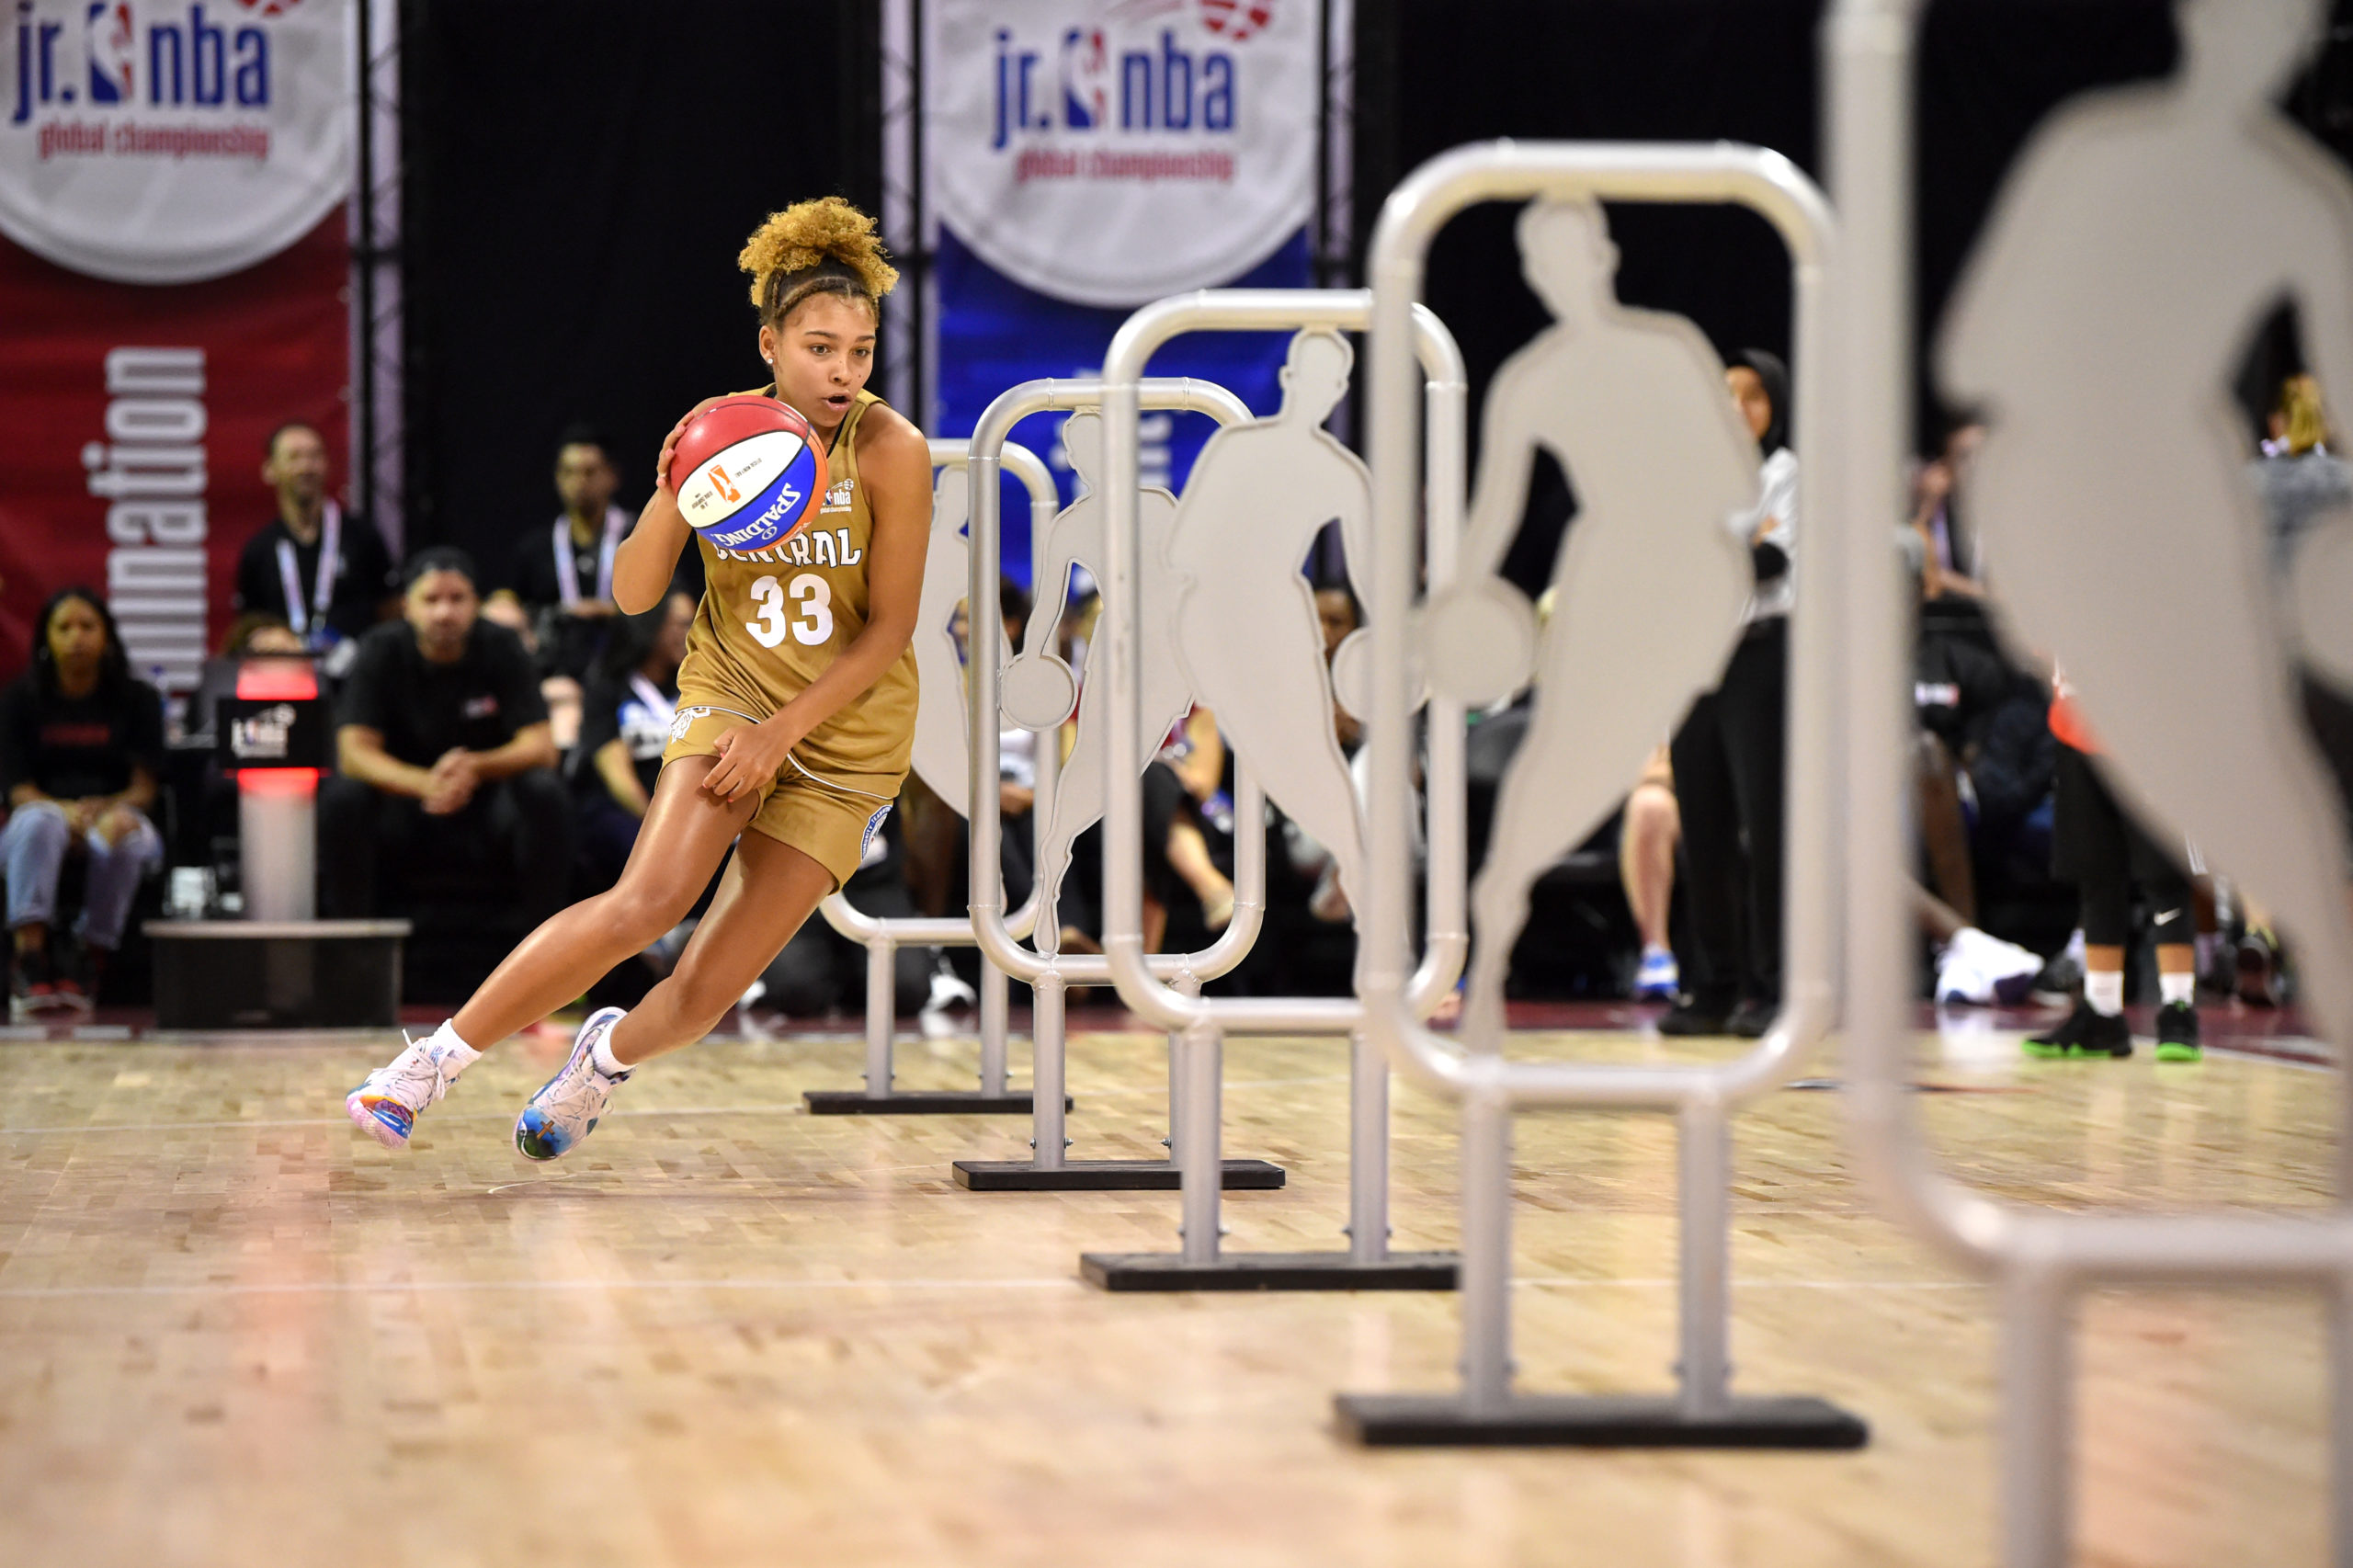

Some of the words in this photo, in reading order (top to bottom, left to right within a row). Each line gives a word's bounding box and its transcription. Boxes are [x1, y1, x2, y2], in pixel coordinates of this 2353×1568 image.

[11, 0, 76, 125] jr.
[148, 3, 270, 107] nba
[992, 28, 1051, 150] jr.
[1120, 30, 1237, 131] nba
[712, 482, 801, 547] SPALDING
[833, 489, 851, 506] nba
[745, 574, 834, 649] 33
